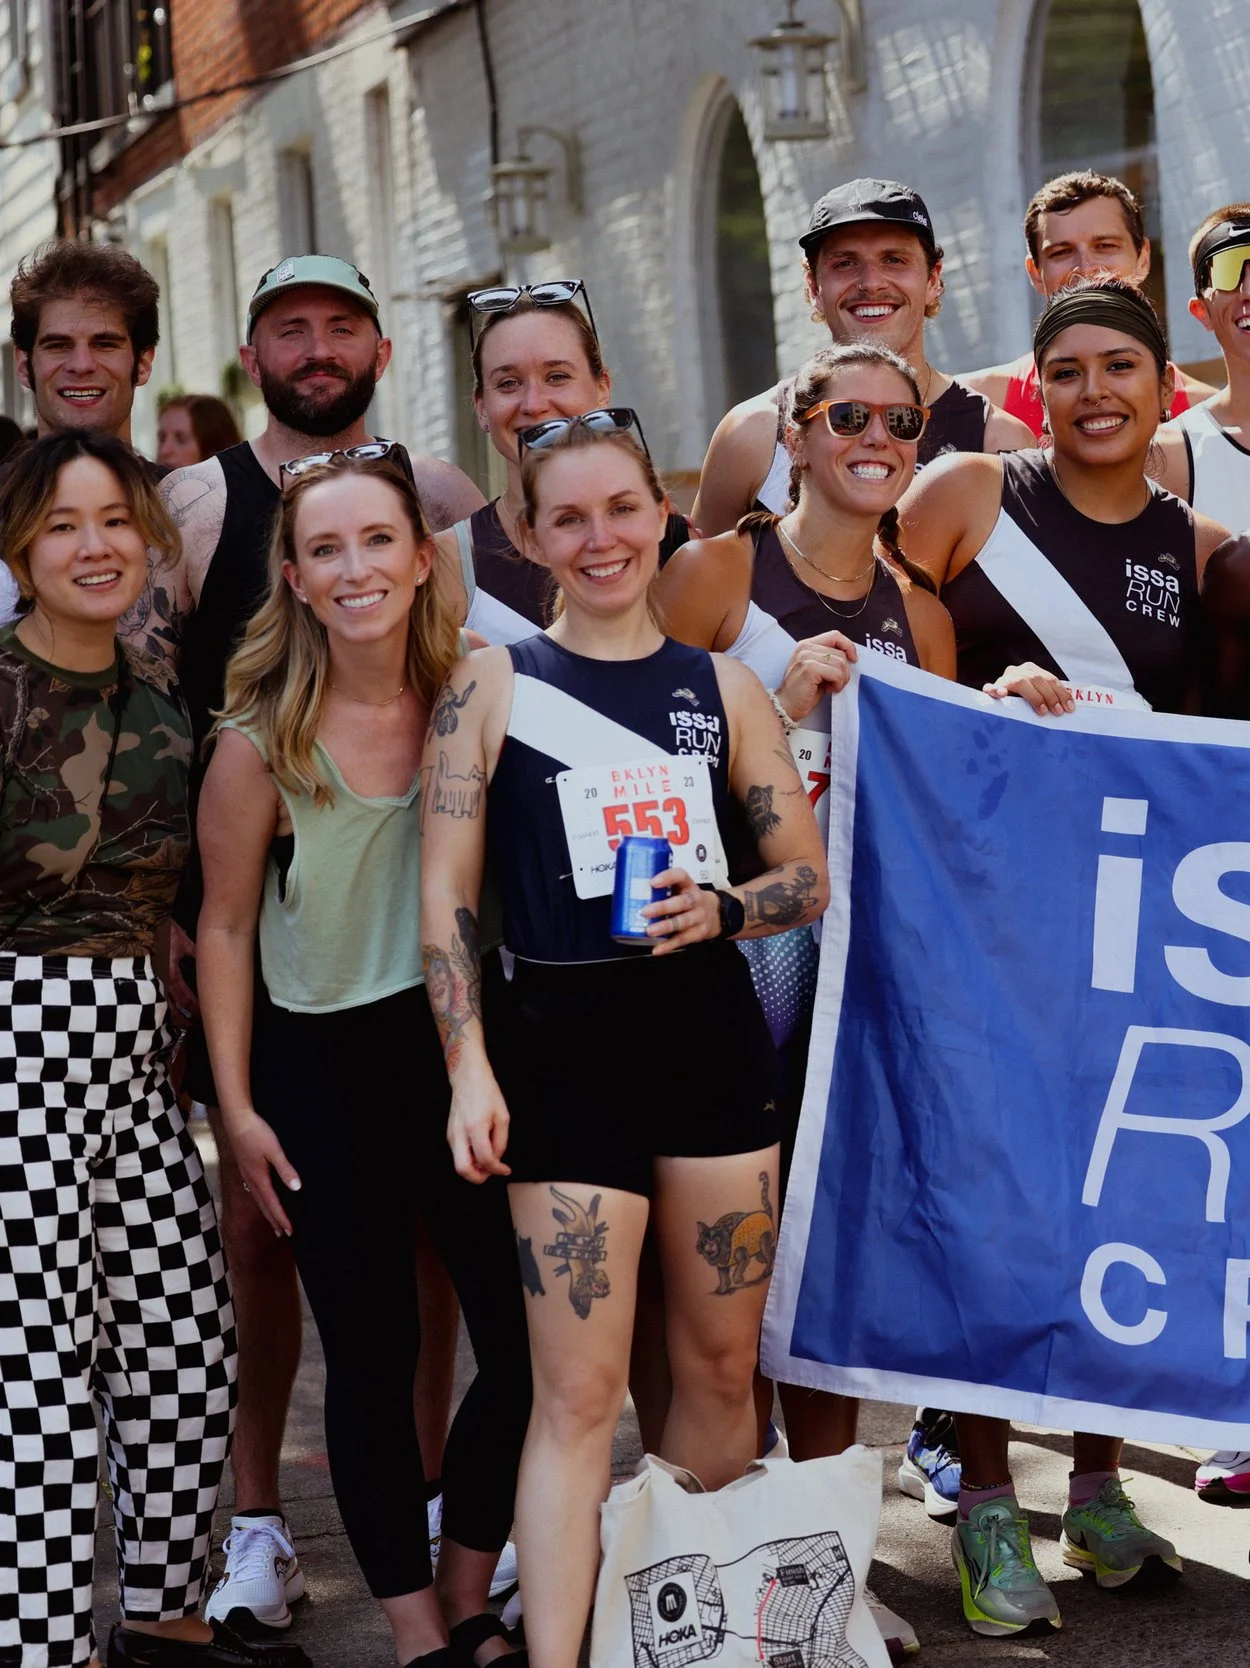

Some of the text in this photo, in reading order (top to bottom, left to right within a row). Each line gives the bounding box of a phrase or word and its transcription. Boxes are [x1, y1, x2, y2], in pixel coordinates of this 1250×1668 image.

[1125, 558, 1179, 594] issa
[1126, 580, 1180, 614] RUN
[1126, 600, 1180, 628] CREW
[865, 633, 907, 663] issa
[1066, 687, 1114, 704] KLYN
[669, 711, 720, 733] issa
[676, 727, 721, 754] RUN
[799, 749, 812, 760] 20
[611, 764, 669, 782] BKLYN
[584, 777, 694, 799] 20 MILE 23
[602, 797, 690, 852] 553
[658, 1624, 697, 1648] HOKA
[773, 1654, 796, 1665] Start
